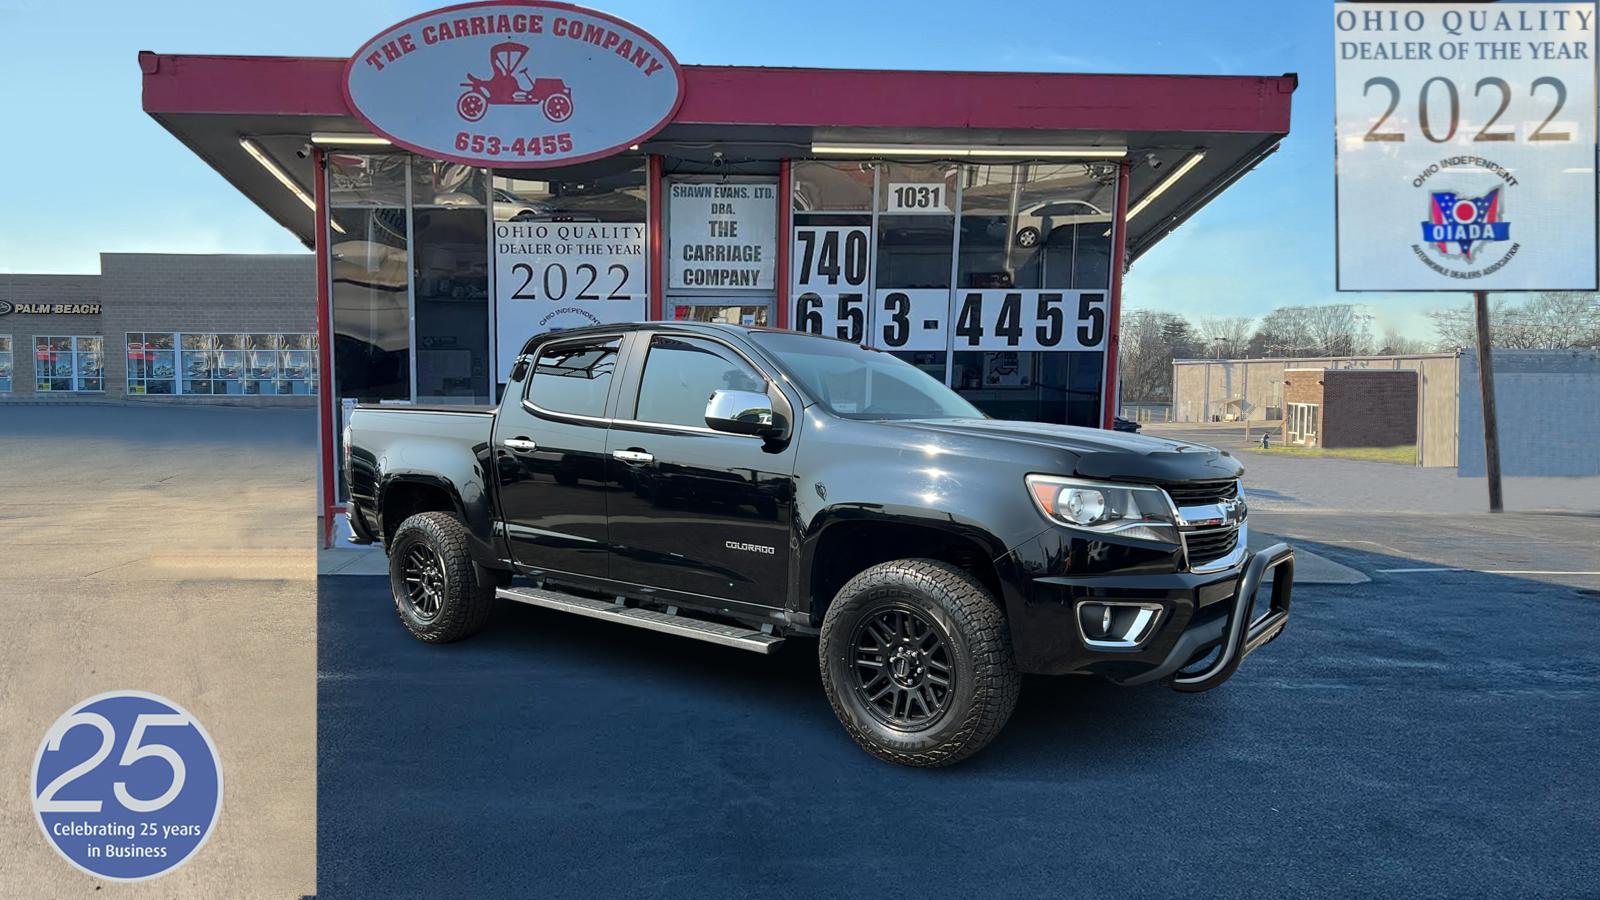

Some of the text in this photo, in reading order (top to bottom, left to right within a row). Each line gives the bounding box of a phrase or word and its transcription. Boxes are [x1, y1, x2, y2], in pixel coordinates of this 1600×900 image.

[1336, 10, 1593, 35] OHIO QUALITY
[366, 14, 664, 77] THE CARRIAGE COMPANY
[1340, 42, 1589, 60] DEALER OF THE YEAR
[1363, 76, 1571, 143] 2022
[455, 132, 573, 157] 653-4455
[1412, 156, 1519, 188] OHIO INDEPENDENT
[672, 186, 712, 199] SHAWN
[754, 187, 774, 199] LTD.
[894, 187, 940, 208] 1031
[711, 203, 736, 215] DBA.
[497, 226, 644, 240] OHIO QUALITY
[709, 221, 738, 238] THE
[1433, 224, 1495, 240] OIADA
[499, 244, 641, 255] DEALER OF THE YEAR
[683, 245, 762, 262] CARRIAGE
[797, 230, 868, 286] 740
[1411, 242, 1521, 279] AUTOMOBILE DEALERS ASSOCIATION
[511, 263, 632, 301] 2022
[683, 268, 760, 286] COMPANY
[15, 304, 100, 314] PALM BEACH
[539, 307, 600, 326] OHIO INDEPENDENT
[725, 540, 775, 554] COLORADO
